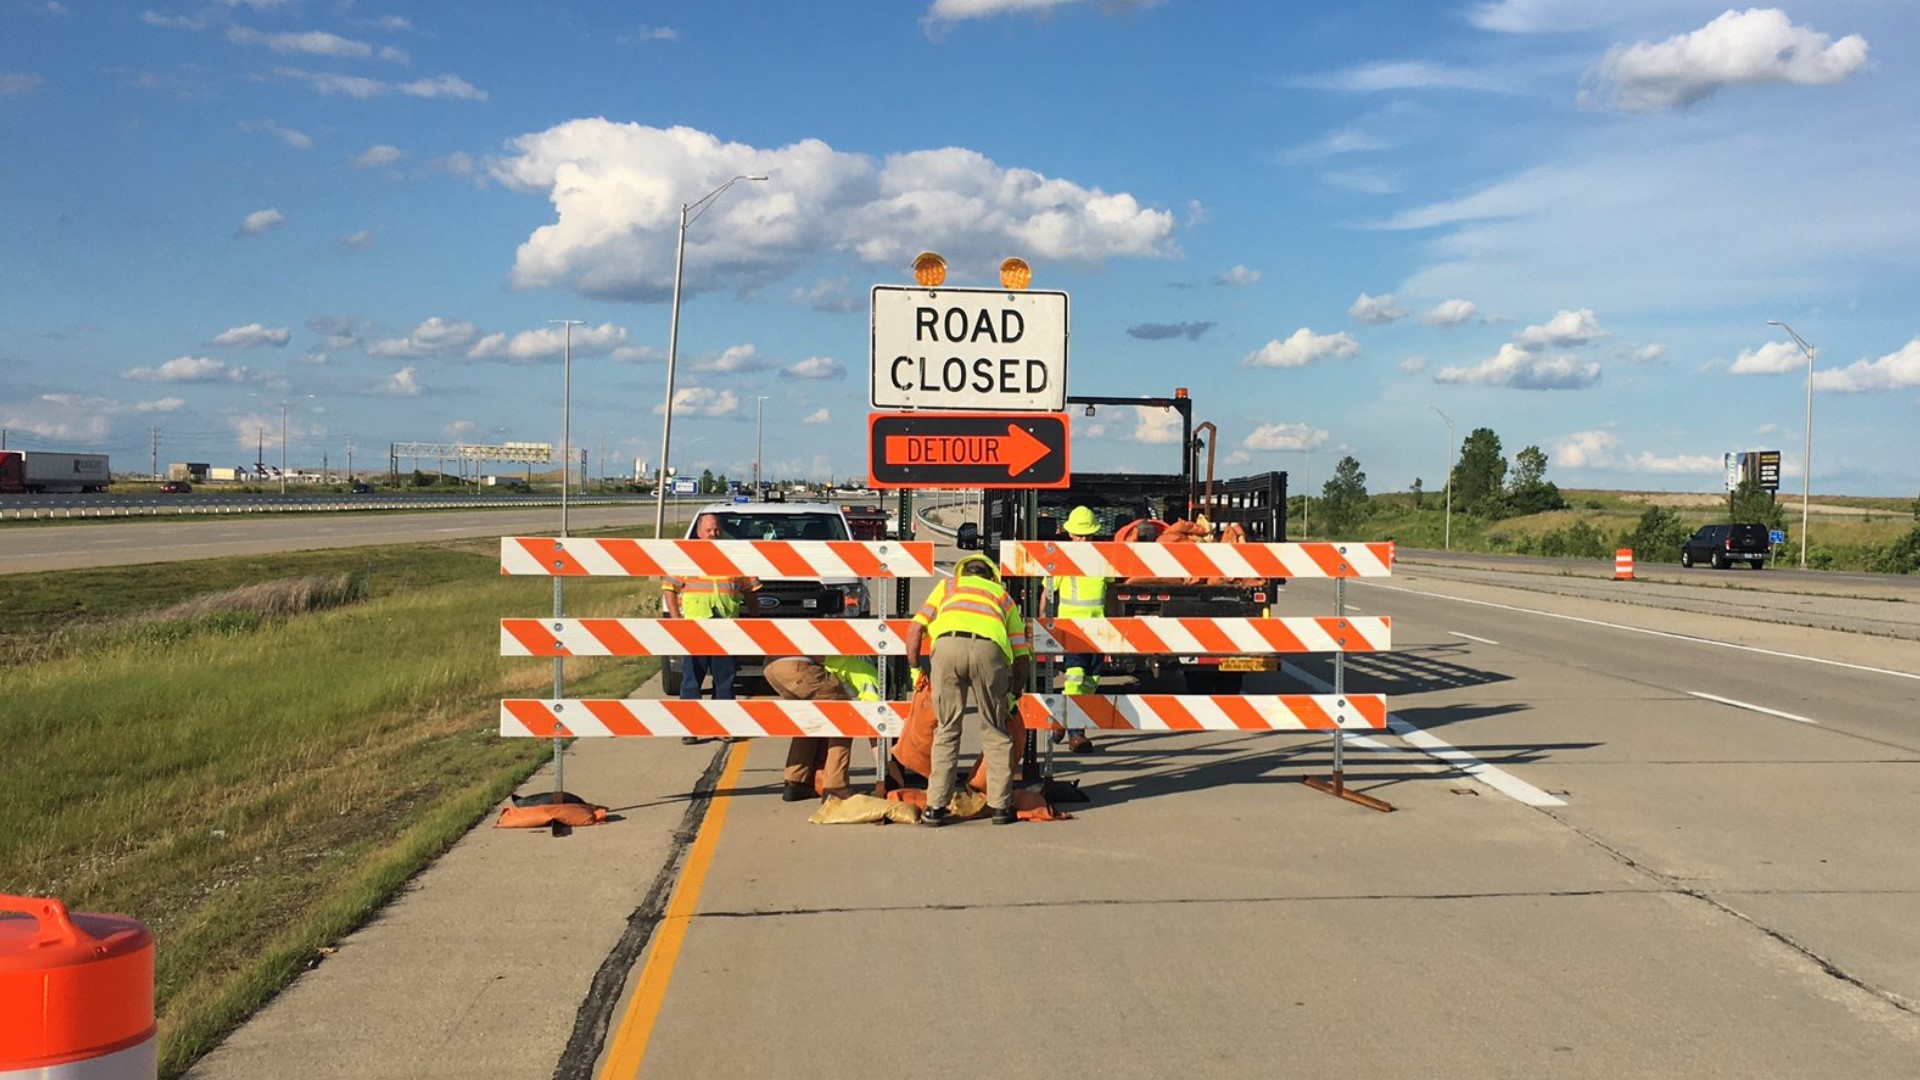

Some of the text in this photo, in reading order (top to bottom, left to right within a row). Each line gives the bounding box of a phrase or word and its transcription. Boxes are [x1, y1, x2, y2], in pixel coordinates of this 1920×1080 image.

[916, 307, 1025, 343] ROAD
[891, 356, 1048, 393] CLOSED
[908, 438, 1000, 462] DETOUR
